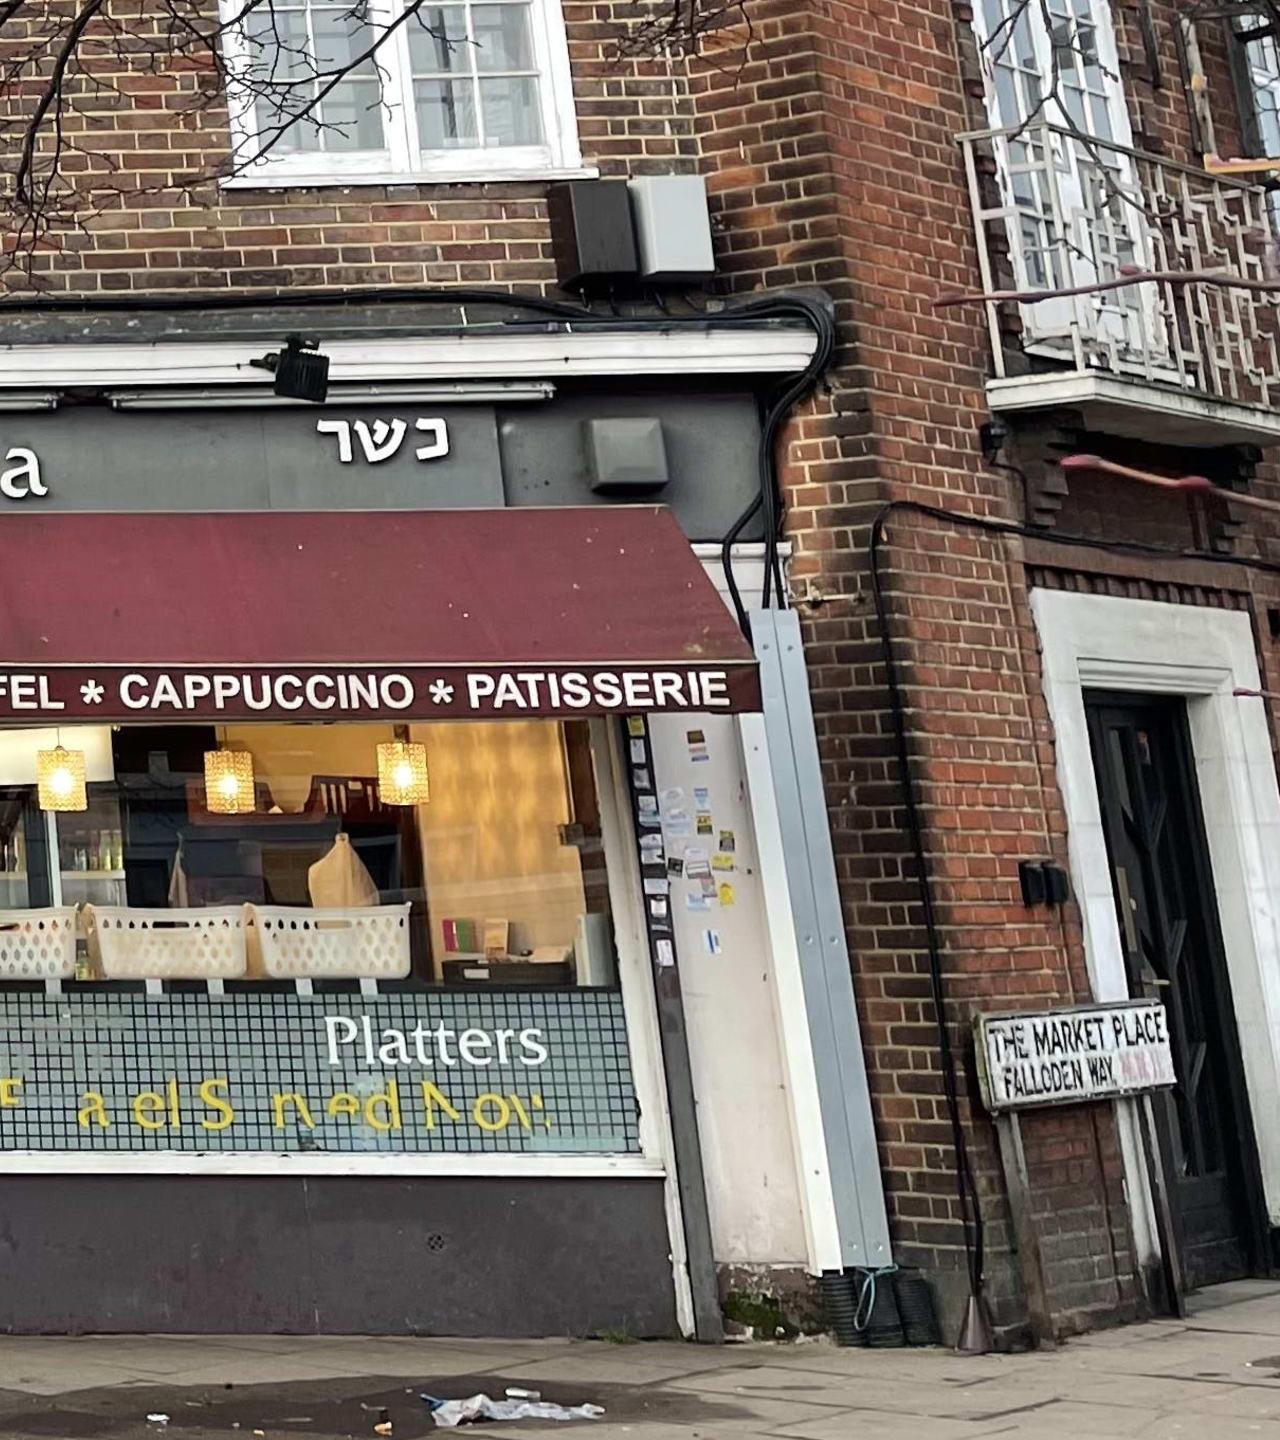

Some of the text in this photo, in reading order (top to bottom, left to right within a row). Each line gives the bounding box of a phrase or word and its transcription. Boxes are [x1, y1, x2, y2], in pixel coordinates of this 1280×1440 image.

[317, 417, 450, 462] כשר
[119, 672, 414, 710] CAPPUCCINO
[467, 671, 730, 708] PATISSERIE
[324, 1014, 548, 1067] Platters
[989, 1011, 1167, 1062] THE MARKET PLACE
[1003, 1059, 1084, 1099] FALLODEN
